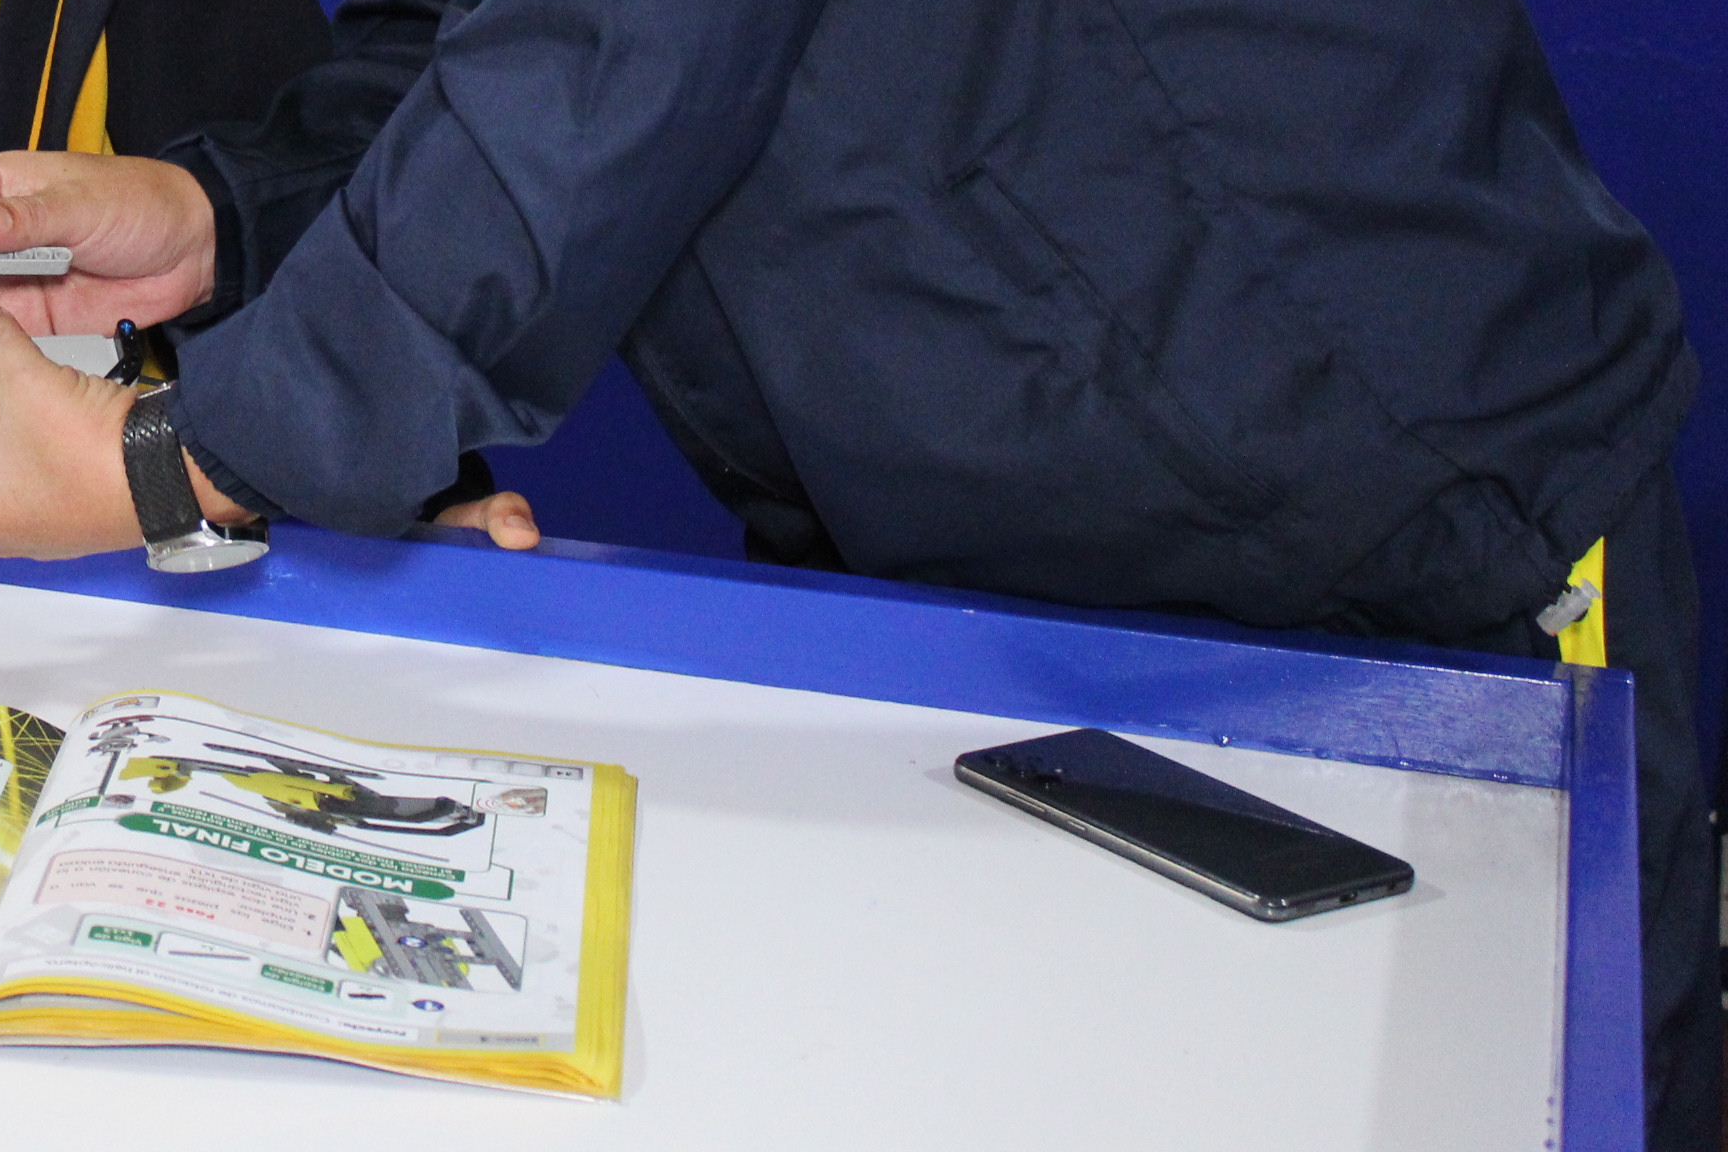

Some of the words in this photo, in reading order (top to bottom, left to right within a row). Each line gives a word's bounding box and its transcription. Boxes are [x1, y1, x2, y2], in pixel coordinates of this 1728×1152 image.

[153, 818, 251, 854] FINAL
[260, 848, 413, 893] MODELO
[175, 906, 216, 921] Paso
